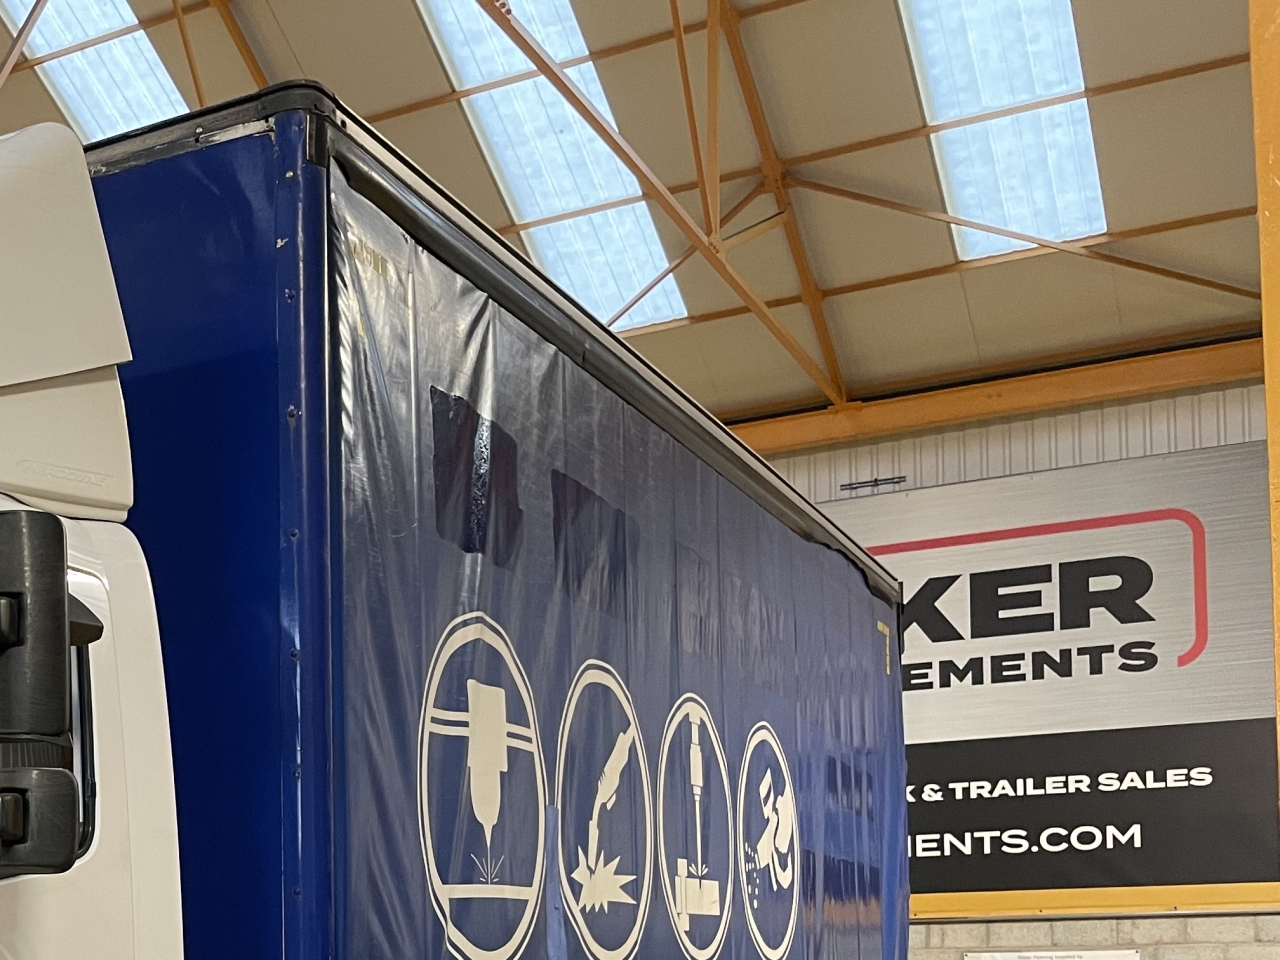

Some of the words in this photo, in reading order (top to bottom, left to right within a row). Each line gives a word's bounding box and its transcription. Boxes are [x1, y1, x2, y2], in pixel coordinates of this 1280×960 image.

[921, 783, 944, 801] &
[948, 774, 1091, 800] TRAILER
[1097, 766, 1213, 792] SALES
[907, 823, 1142, 858] ENTS.COM
